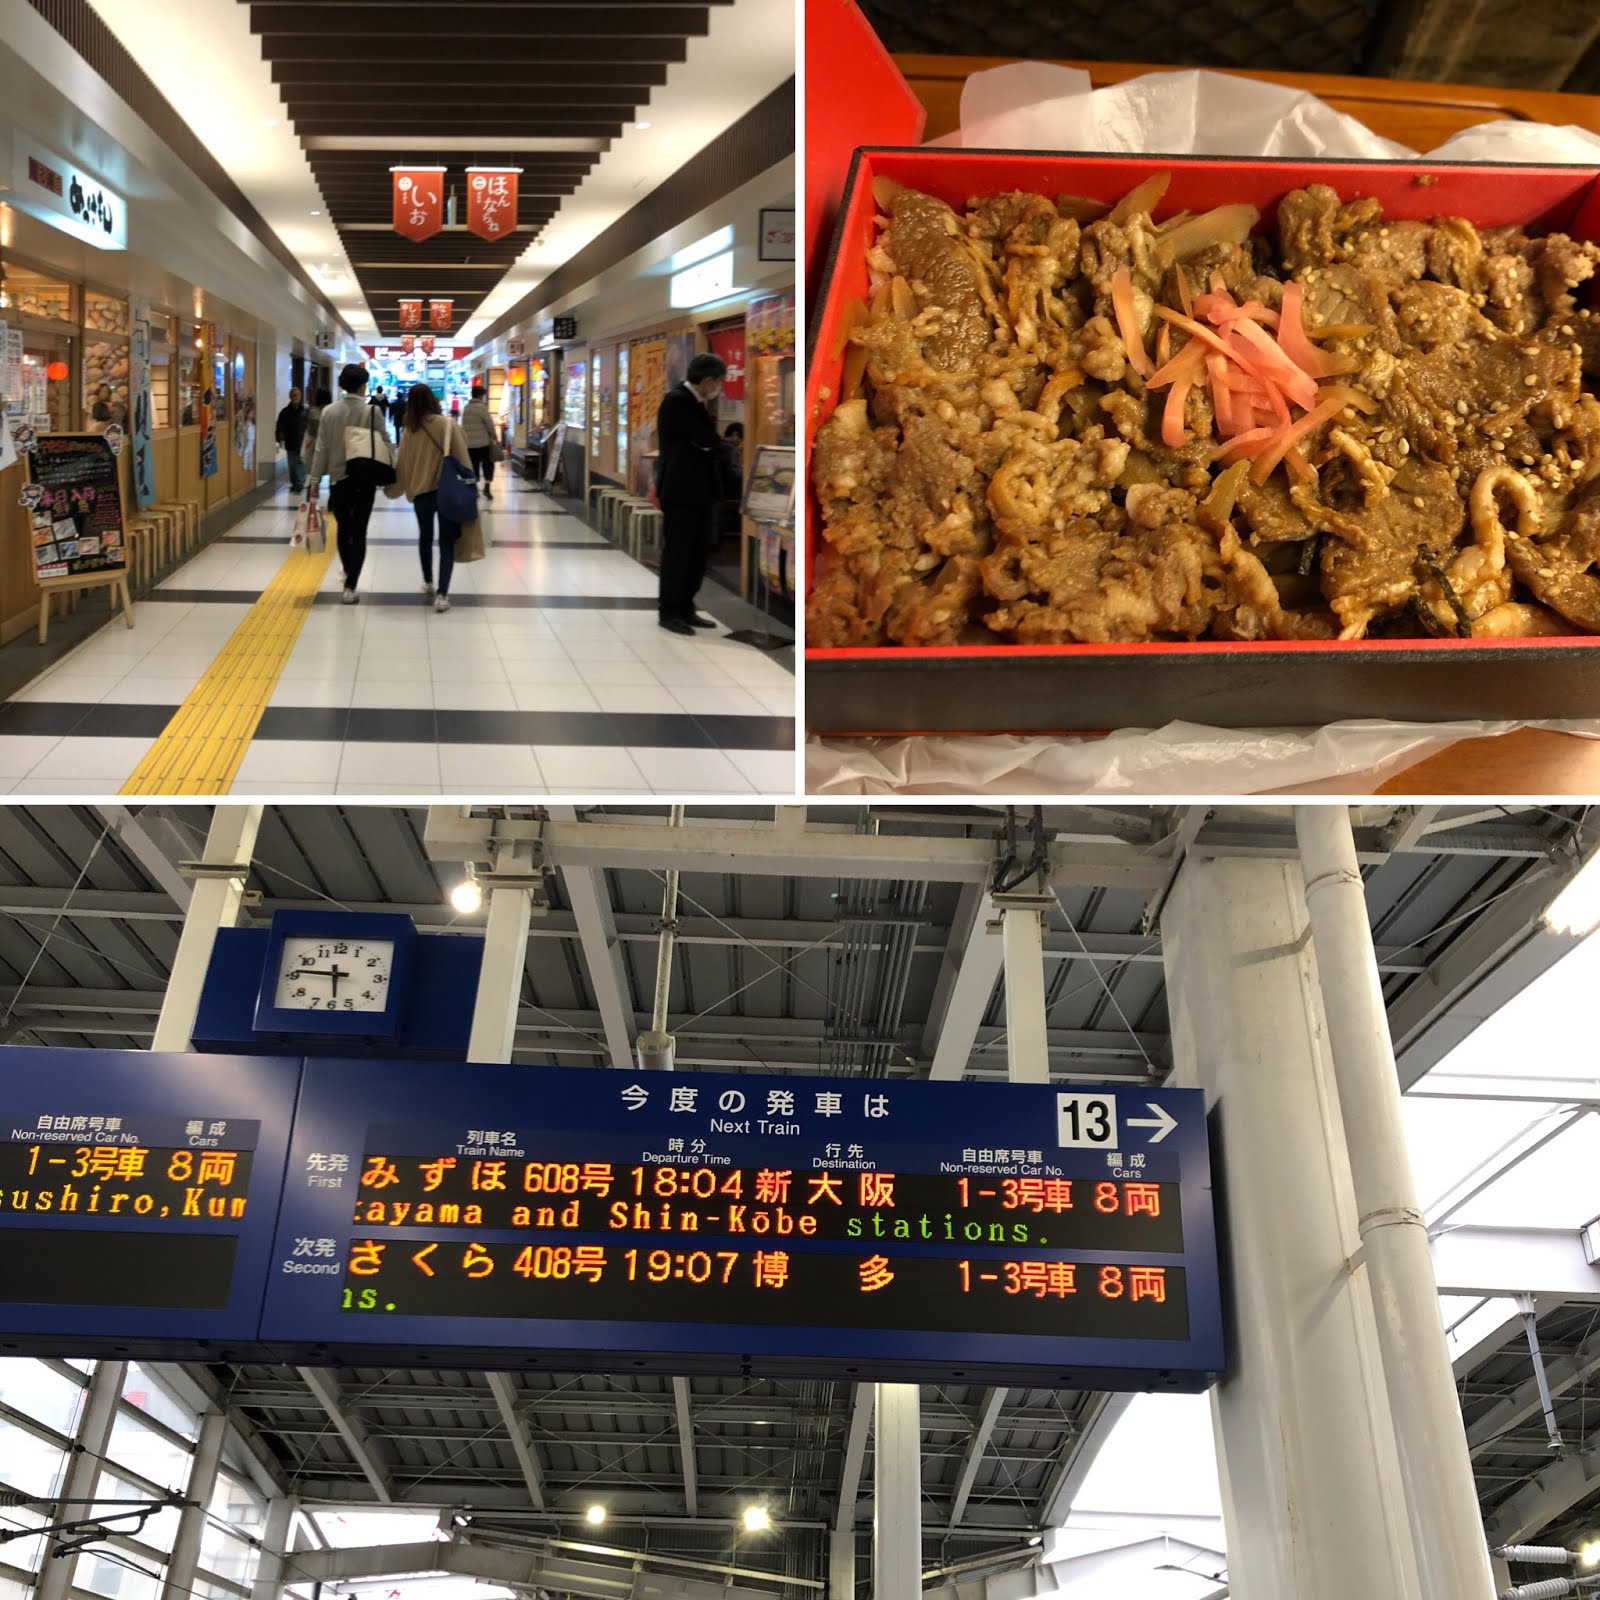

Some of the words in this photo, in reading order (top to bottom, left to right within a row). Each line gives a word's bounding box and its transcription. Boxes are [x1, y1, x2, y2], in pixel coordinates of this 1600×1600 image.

[318, 950, 330, 958] 11
[333, 946, 348, 954] 12
[301, 958, 316, 966] 10
[621, 1084, 890, 1118] 今度の発車は
[37, 1115, 122, 1132] 自由席号車
[185, 1120, 226, 1136] 編成
[710, 1119, 750, 1135] Next
[757, 1120, 800, 1136] Train
[1062, 1099, 1112, 1142] 13
[12, 1129, 92, 1142] Non-reserved
[95, 1132, 116, 1143] Car
[120, 1133, 140, 1144] No.
[188, 1136, 218, 1147] Cars
[466, 1130, 518, 1147] 列車名
[456, 1144, 488, 1156] Train
[491, 1146, 525, 1158] Name
[668, 1138, 706, 1153] 時分
[826, 1143, 864, 1158] 行先
[306, 1153, 349, 1173] 先発
[642, 1152, 699, 1166] Departure
[703, 1154, 731, 1166] Time
[813, 1157, 876, 1170] Destination
[962, 1148, 1043, 1165] 自由席号車
[1107, 1152, 1146, 1169] 編成
[940, 1162, 1018, 1175] Non-reserved
[1021, 1165, 1042, 1176] Car
[1044, 1166, 1065, 1176] No.
[1112, 1168, 1142, 1178] Cars
[308, 1175, 342, 1188] First
[632, 1168, 743, 1200] 18:04
[756, 1169, 896, 1208] 新大阪
[354, 1201, 483, 1226] ayama
[512, 1201, 580, 1228] and
[846, 1213, 1048, 1244] stations.
[292, 1238, 336, 1258] 次発
[282, 1260, 340, 1275] Second
[624, 1249, 740, 1284] 19:07
